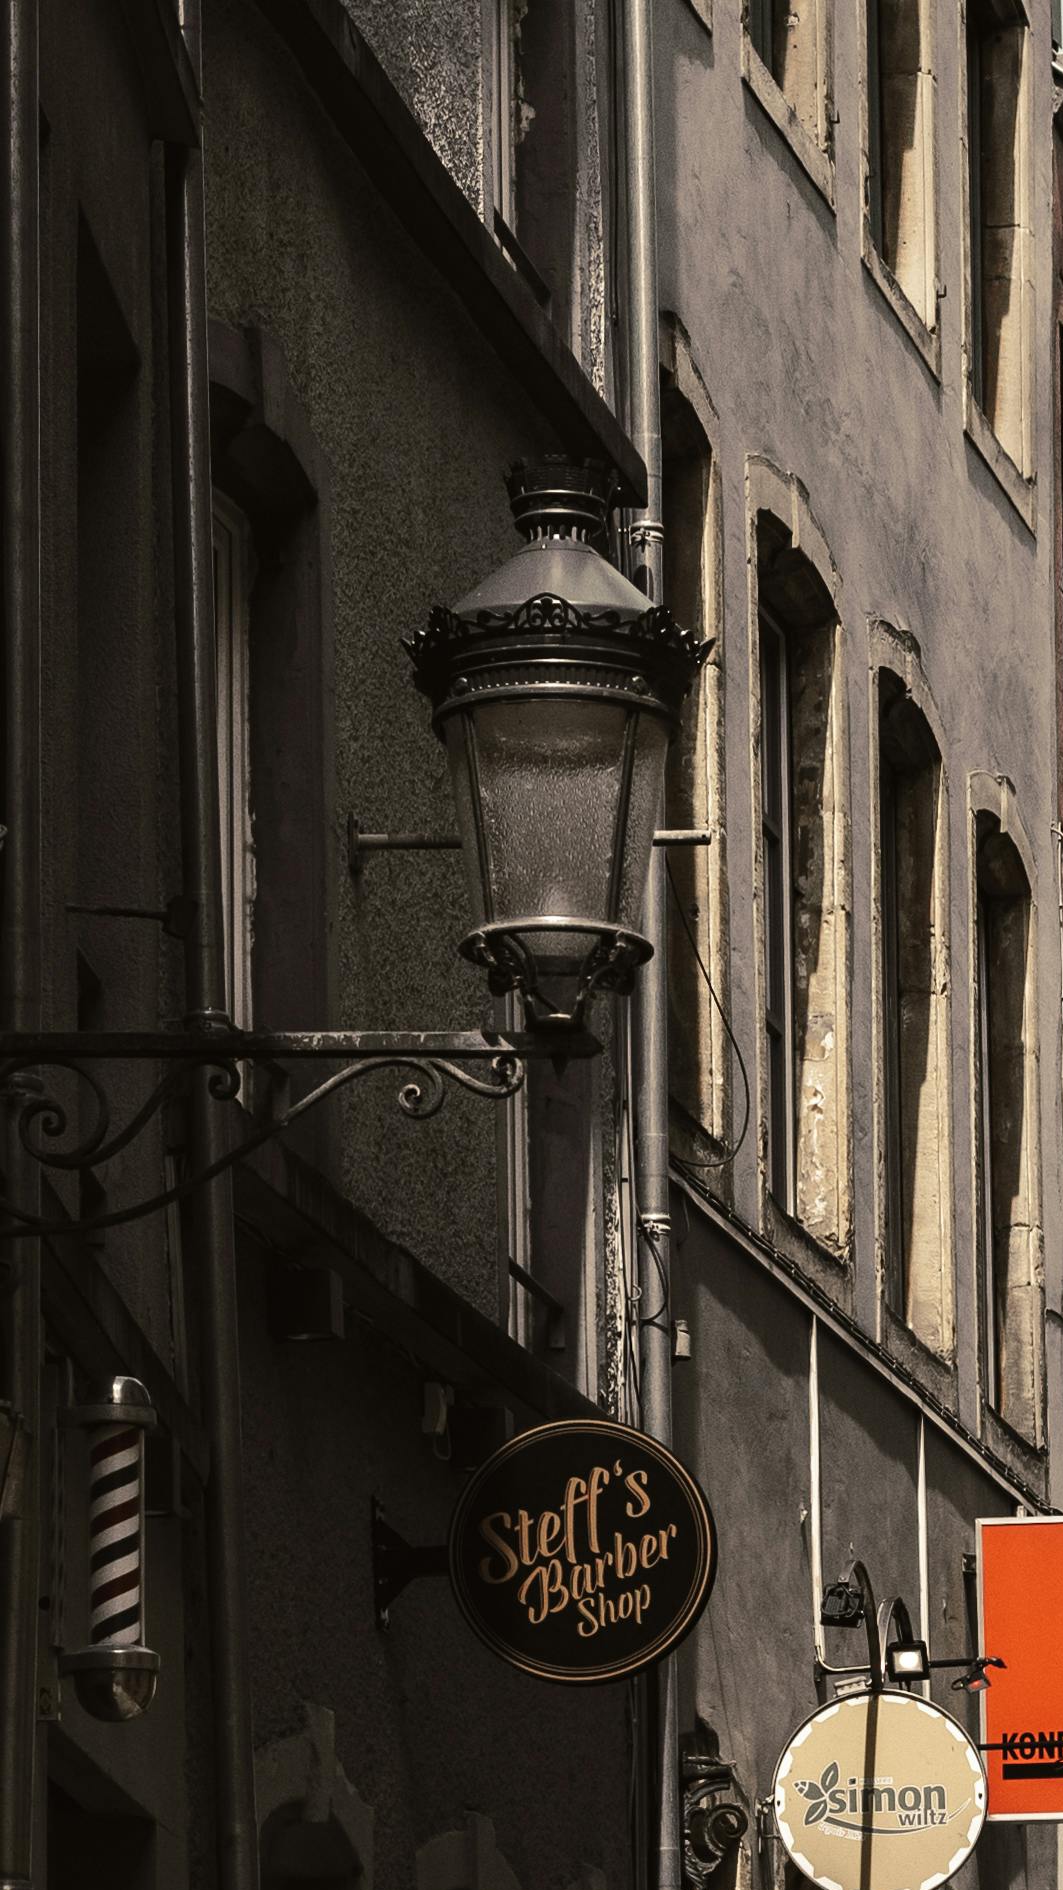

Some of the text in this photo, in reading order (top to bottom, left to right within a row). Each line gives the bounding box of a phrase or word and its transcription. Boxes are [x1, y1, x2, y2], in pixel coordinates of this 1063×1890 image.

[518, 1523, 677, 1624] Barber
[577, 1584, 651, 1638] Shop
[828, 1778, 946, 1813] simon
[898, 1808, 947, 1826] wiltz
